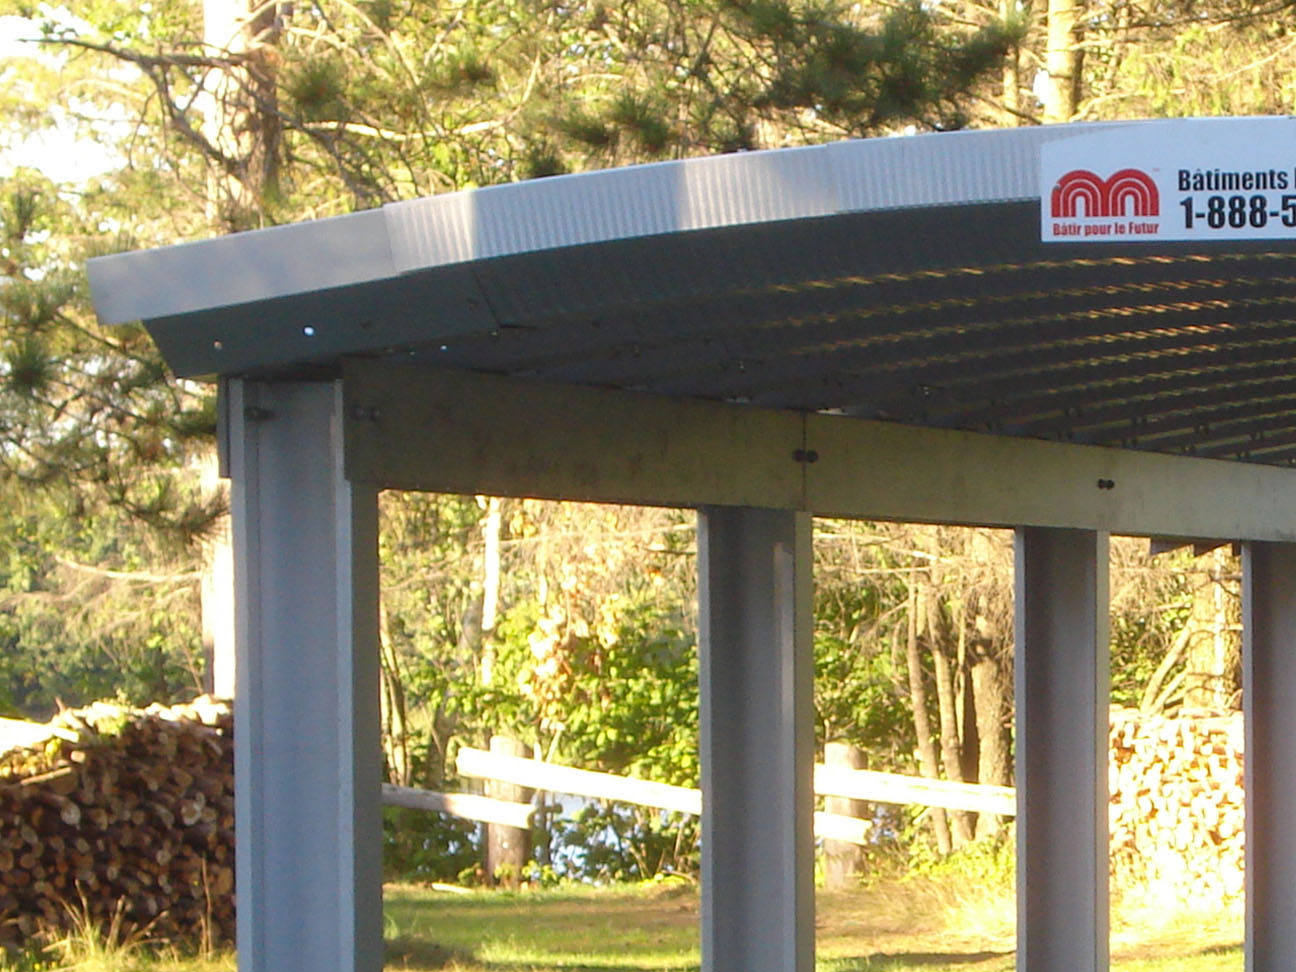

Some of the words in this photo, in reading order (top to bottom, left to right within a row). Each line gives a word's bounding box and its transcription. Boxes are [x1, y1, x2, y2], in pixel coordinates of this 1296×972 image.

[1178, 168, 1288, 191] Bâtiments
[1084, 224, 1111, 236] pour
[1114, 223, 1126, 235] le
[1129, 222, 1159, 235] Futur
